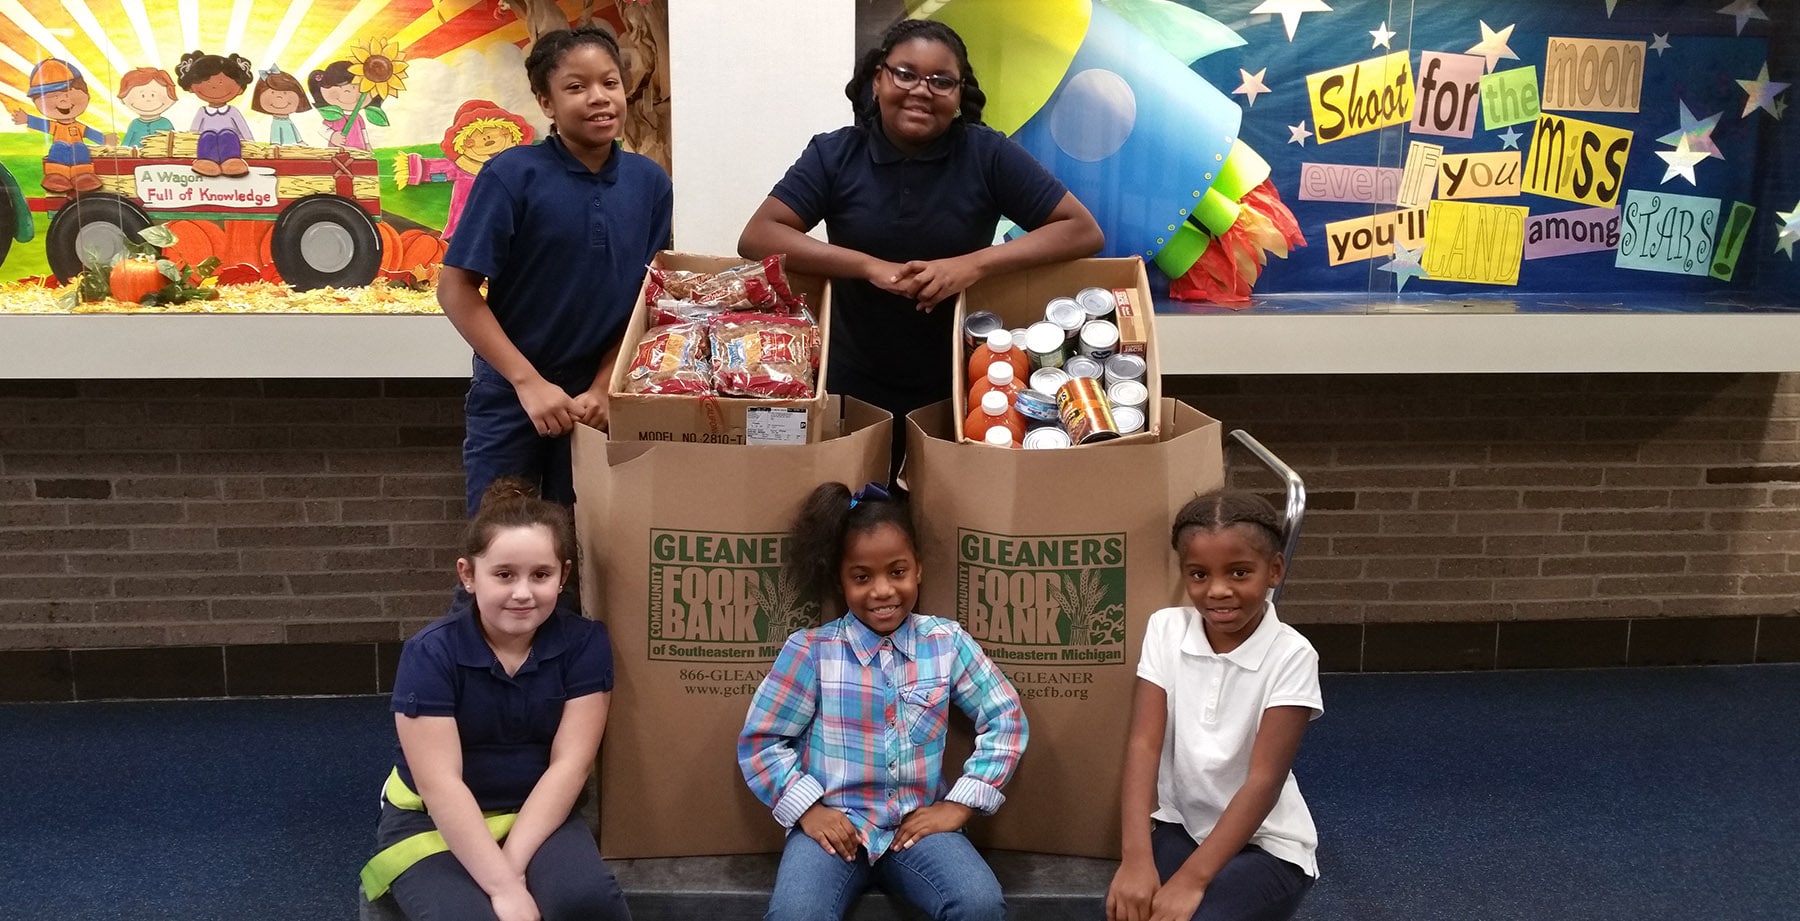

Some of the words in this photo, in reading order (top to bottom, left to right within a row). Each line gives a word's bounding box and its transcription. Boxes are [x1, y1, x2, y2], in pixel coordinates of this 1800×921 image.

[1319, 63, 1409, 139] Shoot
[1419, 58, 1479, 131] for
[1485, 77, 1538, 123] the
[1546, 40, 1641, 108] moon
[141, 171, 153, 182] A
[157, 172, 203, 187] Wagon
[1305, 165, 1398, 200] even
[1400, 144, 1441, 206] IF
[1442, 158, 1519, 197] you
[148, 189, 172, 200] Full
[179, 188, 193, 200] of
[200, 188, 271, 205] Knowledge
[1331, 209, 1425, 260] you'll
[1426, 202, 1524, 281] LAND
[1528, 215, 1620, 248] among
[1621, 196, 1714, 272] STARS
[638, 432, 673, 441] MODEL
[703, 433, 746, 445] 2810-T
[653, 534, 787, 564] GLEANE
[961, 534, 1122, 567] GLEANERS
[651, 567, 662, 637] COMMUNITY
[662, 566, 760, 605] FOOD
[958, 562, 969, 631] OMMUNITY
[969, 566, 1062, 608] FOOD
[662, 602, 759, 642] BANK
[969, 603, 1062, 644] BANK
[652, 644, 666, 656] of
[669, 644, 755, 658] Southeastern
[759, 646, 782, 658] Mic
[983, 647, 1058, 661] outheastern
[1062, 649, 1122, 662] Michigan
[679, 669, 771, 681] 866-GLEAN
[685, 684, 756, 698] www.gcfb
